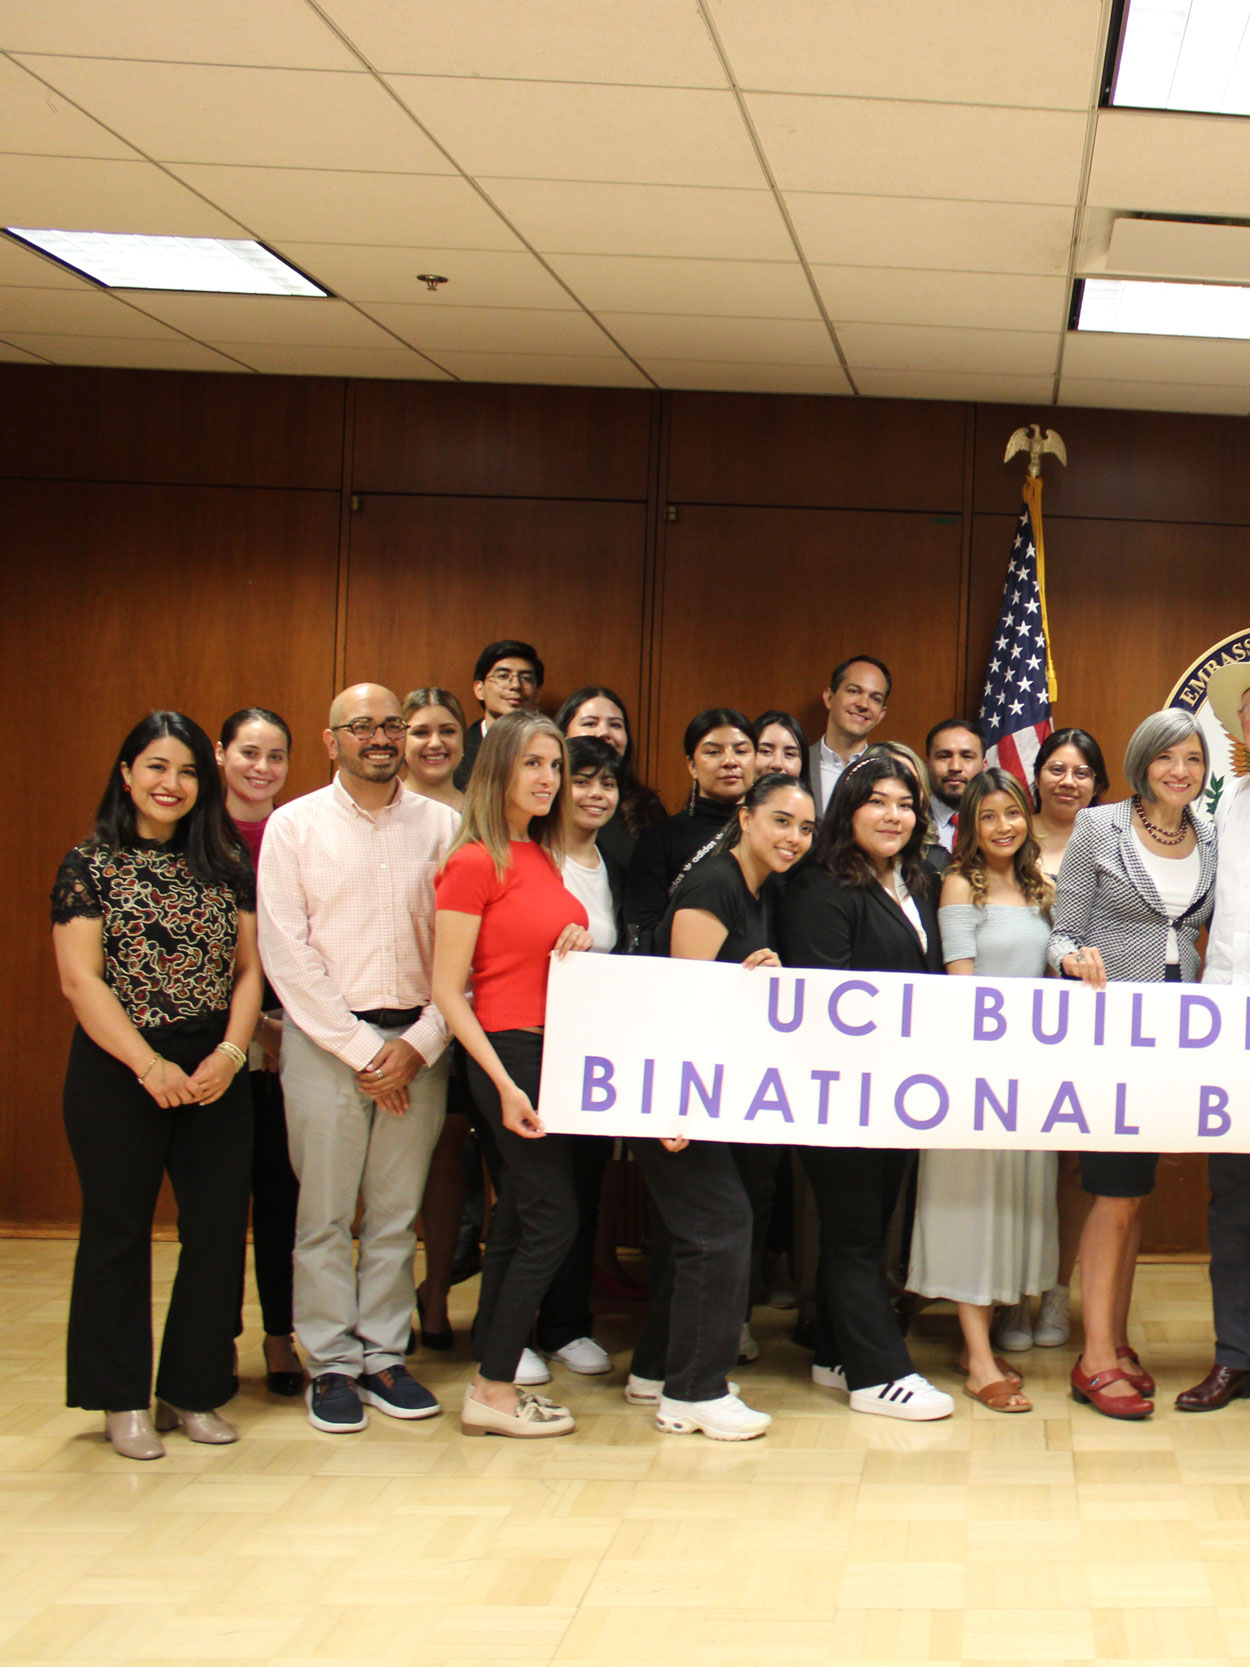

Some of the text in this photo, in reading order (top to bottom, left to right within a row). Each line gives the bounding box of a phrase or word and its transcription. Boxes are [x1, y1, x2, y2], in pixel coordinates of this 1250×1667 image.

[691, 840, 717, 863] adidas
[767, 976, 914, 1038] UCI
[580, 1055, 1140, 1136] BINATIONAL
